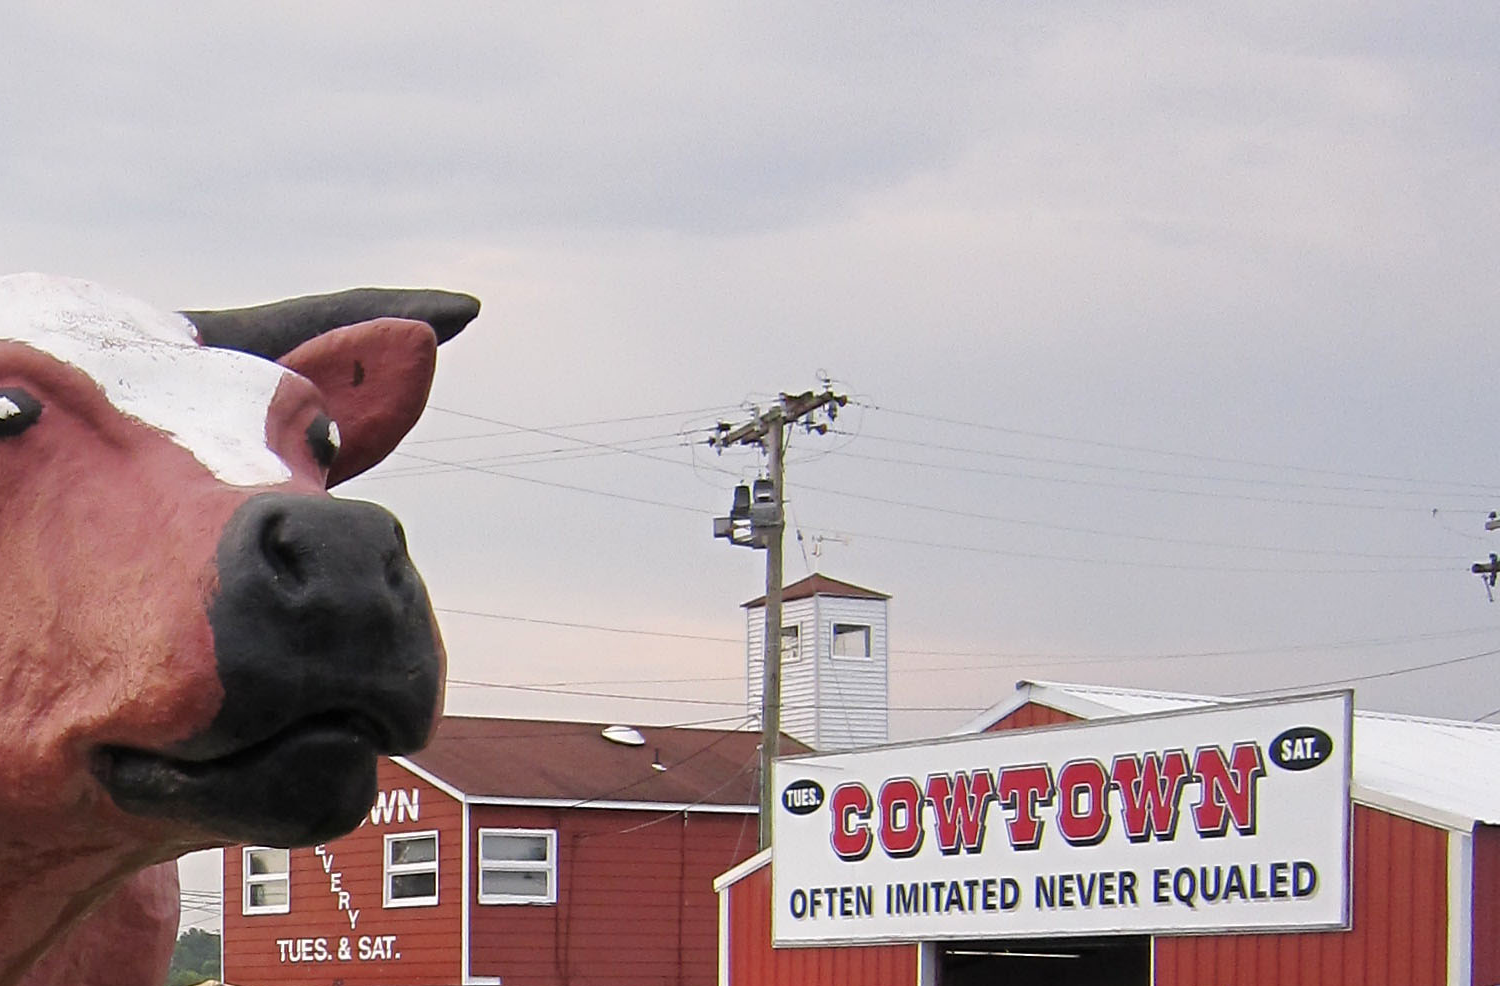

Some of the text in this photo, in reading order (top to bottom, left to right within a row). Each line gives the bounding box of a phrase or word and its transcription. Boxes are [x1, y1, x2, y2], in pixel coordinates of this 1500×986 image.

[1280, 737, 1320, 762] SAT.
[786, 787, 821, 808] TUES.
[830, 741, 1267, 863] COWTOWN
[790, 861, 1318, 919] OFTEN IMITATED NEVER EQUALED
[276, 935, 401, 962] TUES. & SAT.
